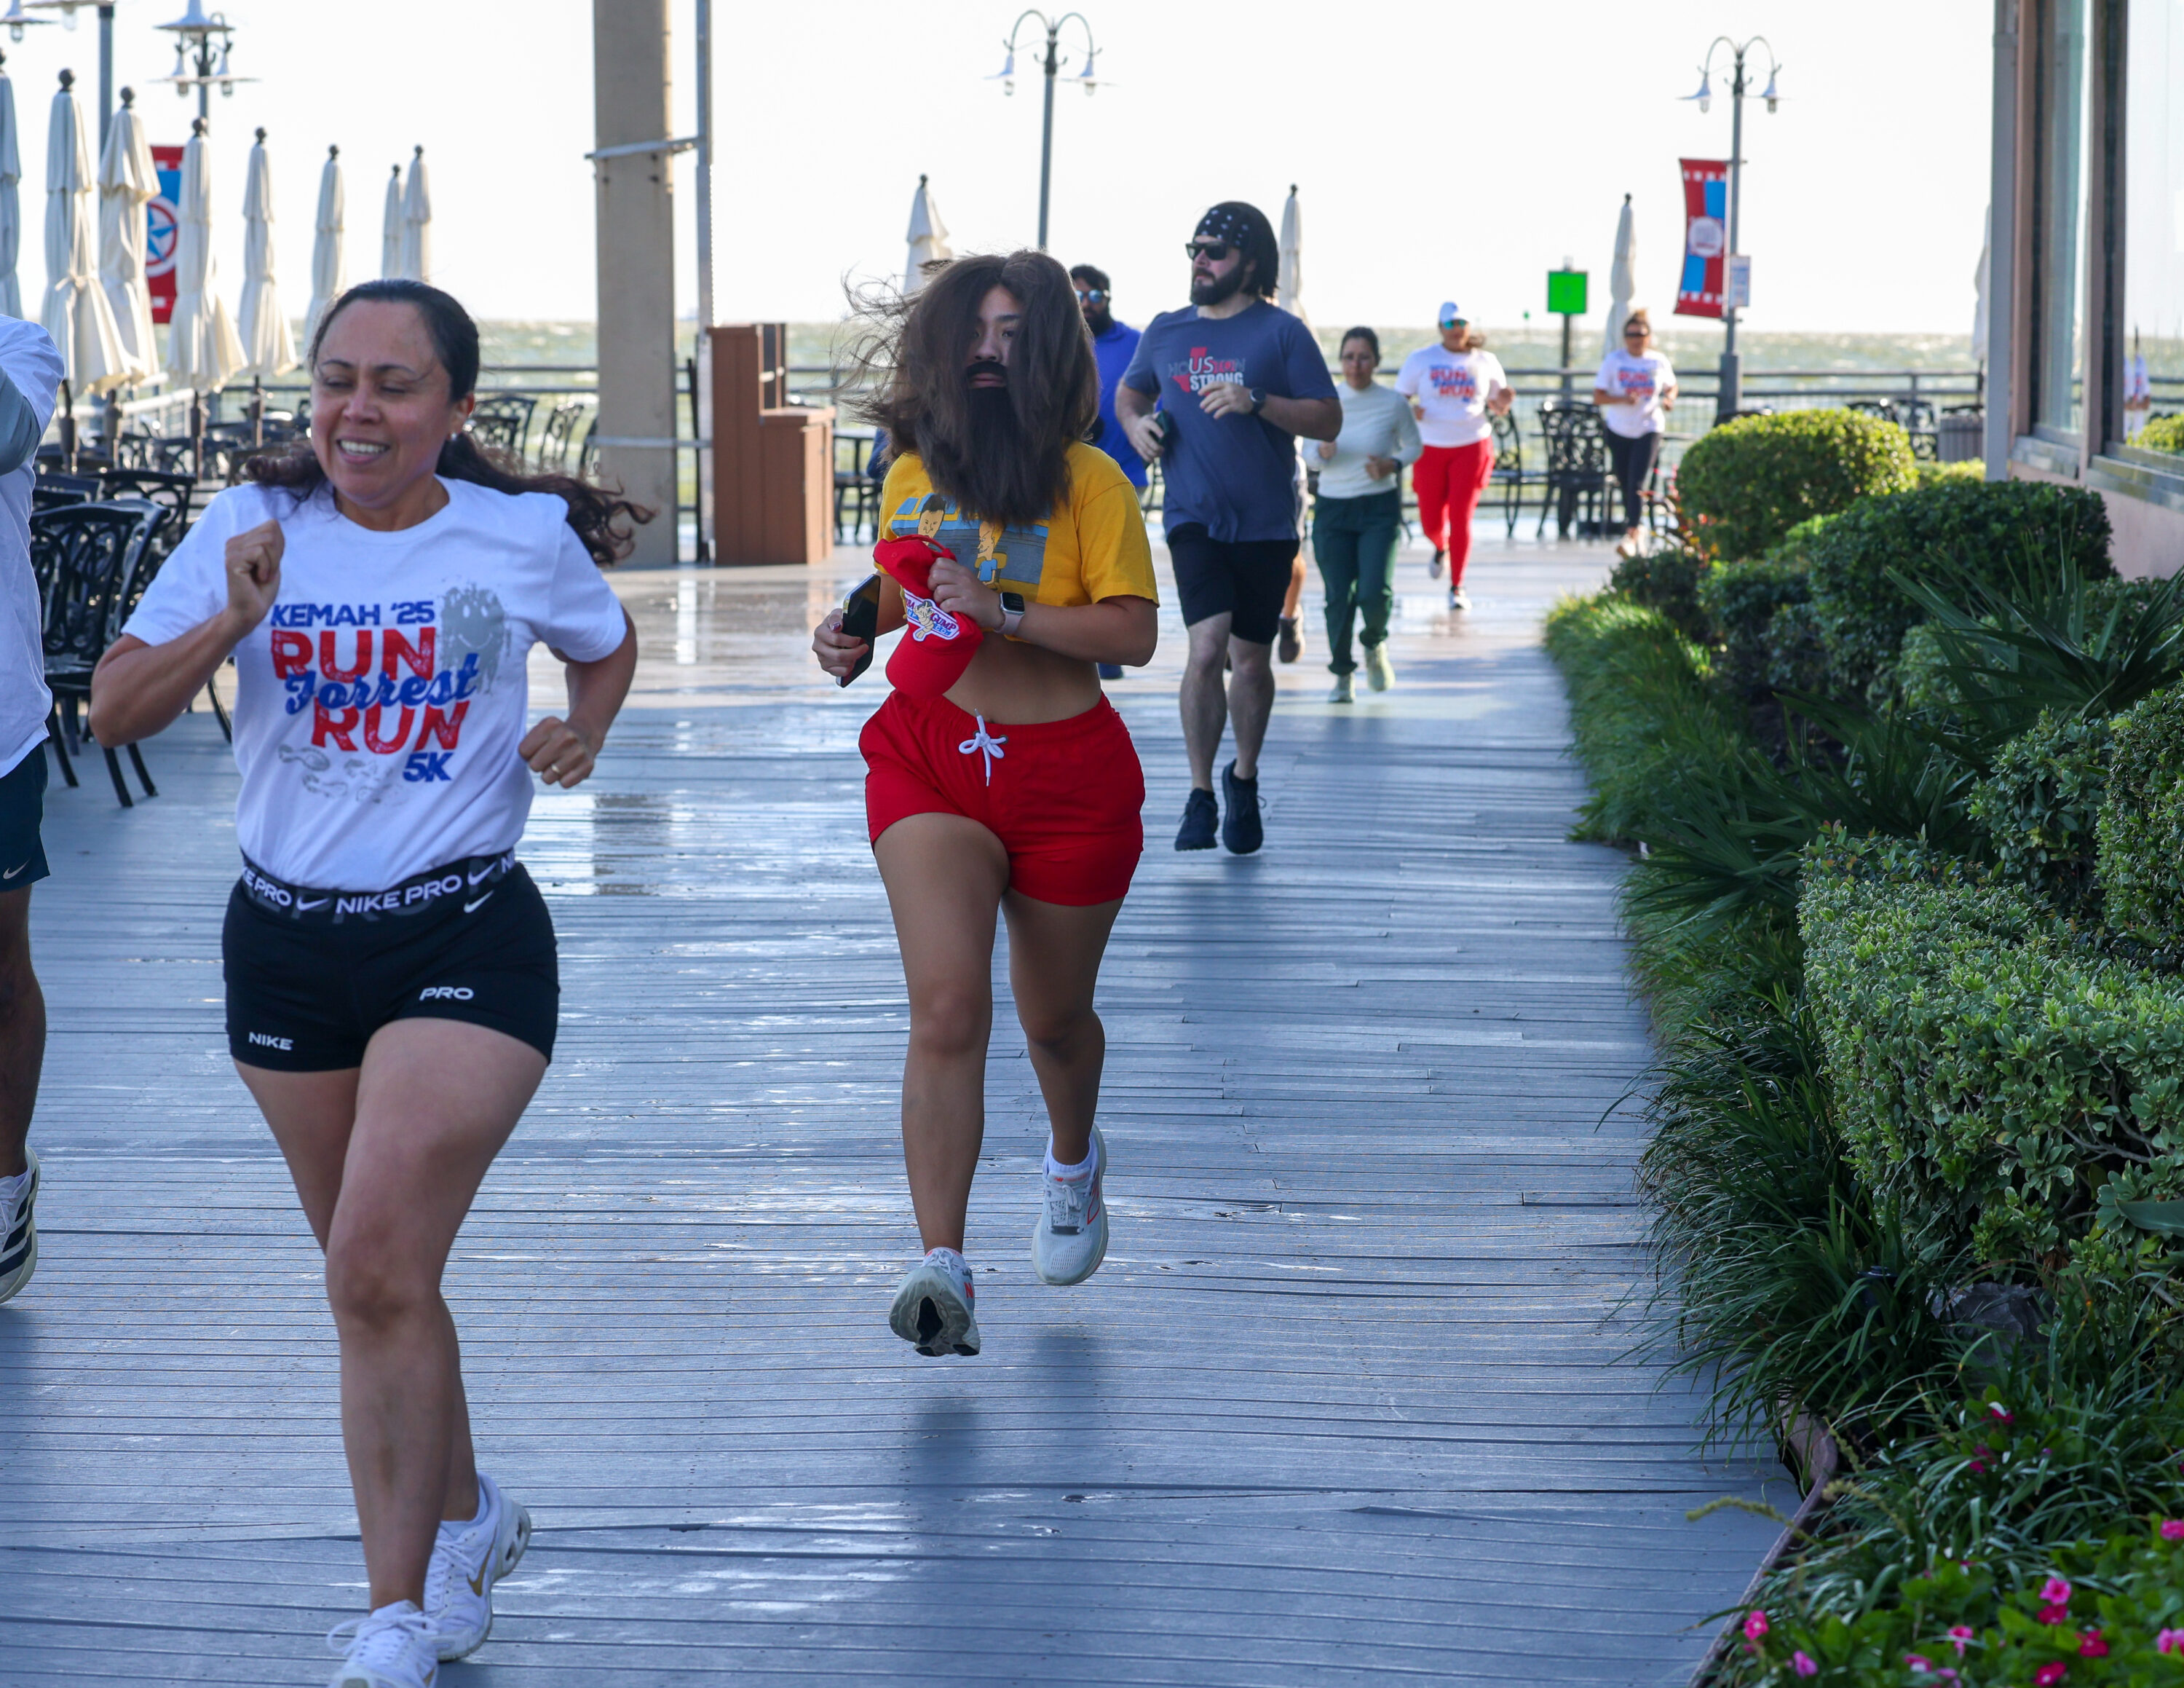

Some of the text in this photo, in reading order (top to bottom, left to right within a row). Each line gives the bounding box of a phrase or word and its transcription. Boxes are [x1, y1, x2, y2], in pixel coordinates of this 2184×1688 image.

[269, 604, 381, 627] KEMAH
[930, 612, 957, 631] GUMP
[270, 626, 436, 683] RUN
[285, 652, 479, 715] Forrest
[311, 697, 471, 754] RUN
[402, 752, 452, 783] 5K
[254, 876, 292, 907] PRO
[335, 874, 463, 915] NIKE PRO
[419, 986, 475, 1001] PRO
[248, 1031, 294, 1051] NIKE
